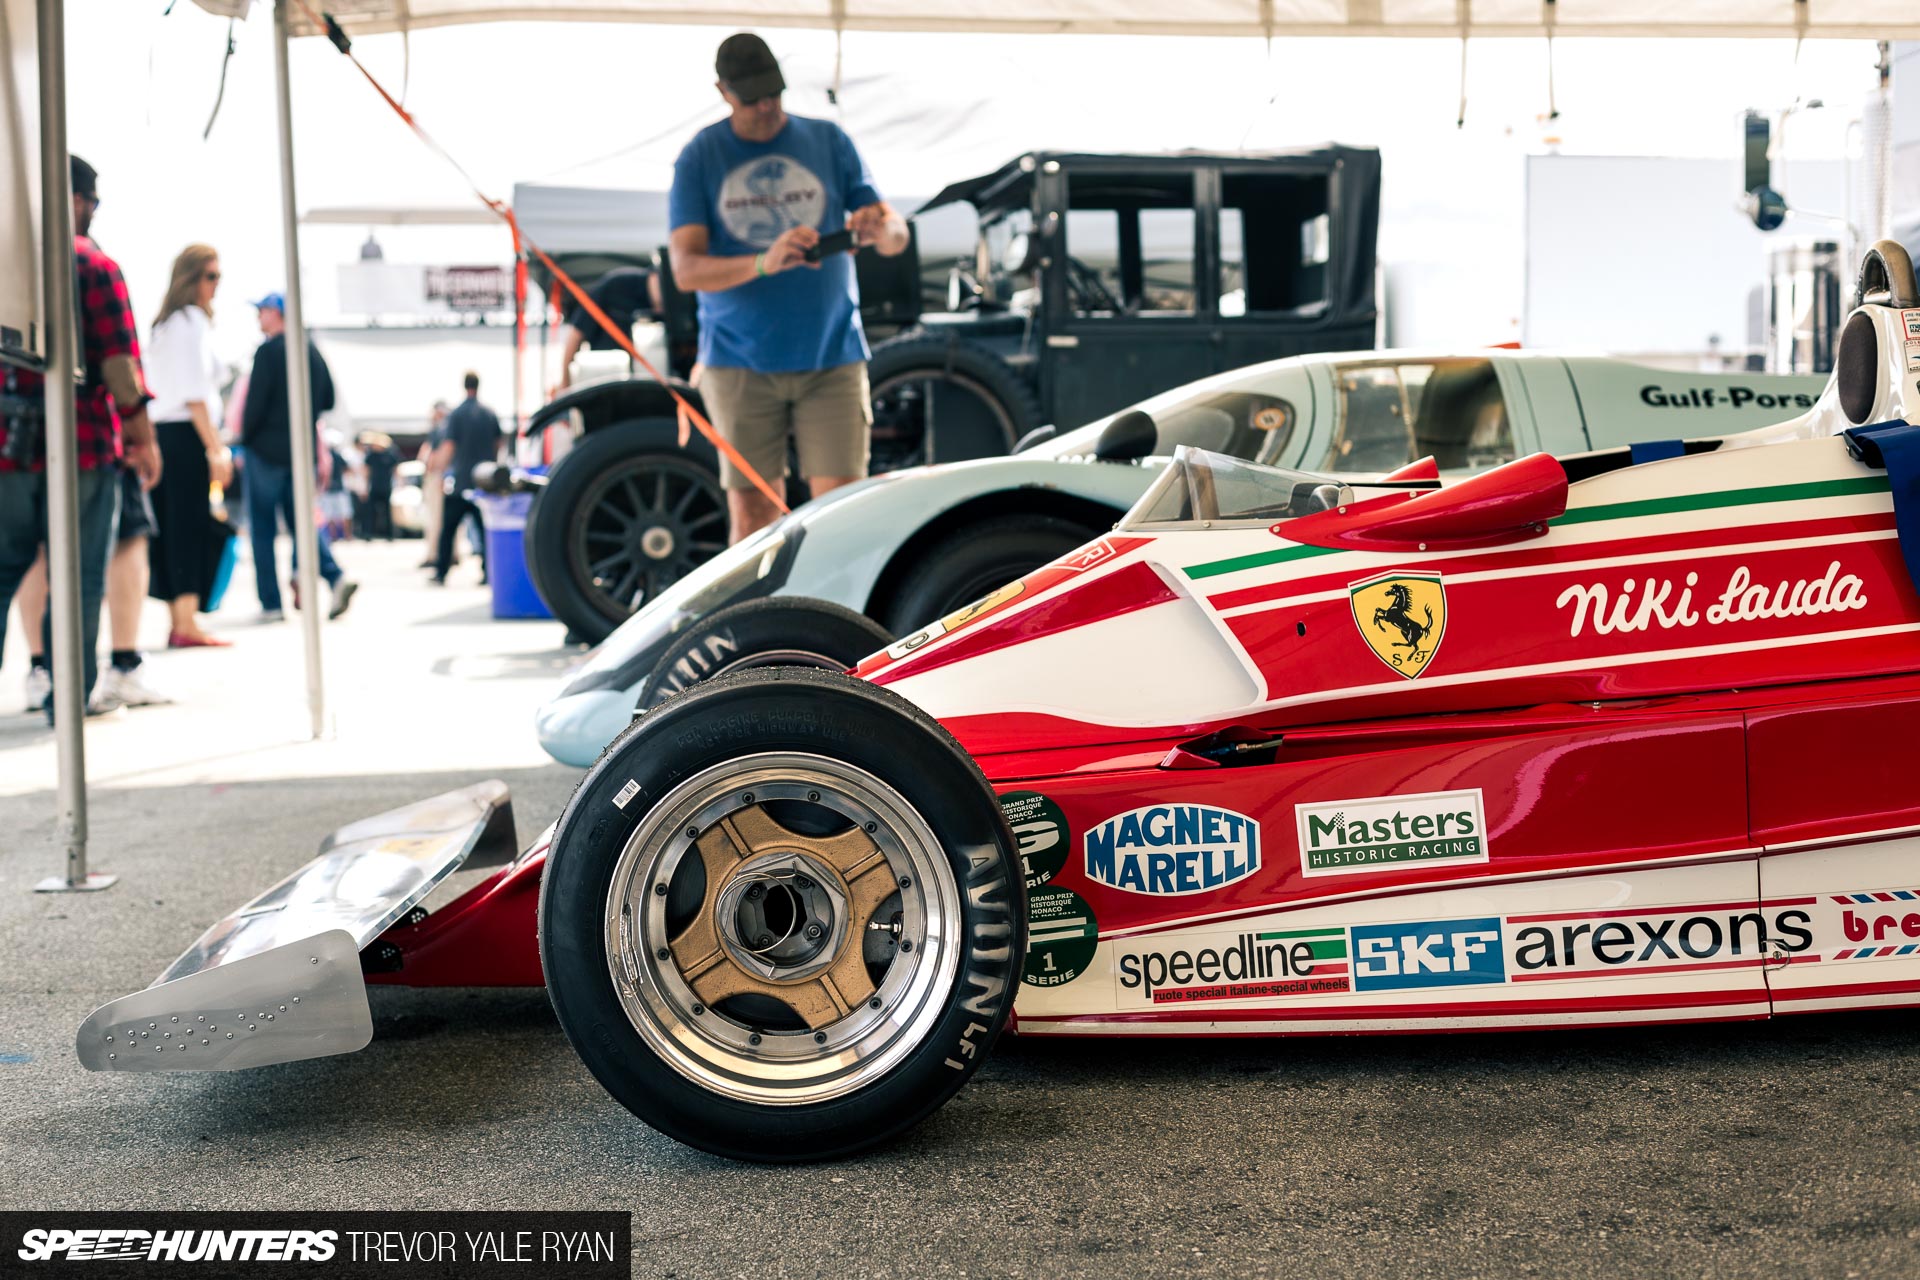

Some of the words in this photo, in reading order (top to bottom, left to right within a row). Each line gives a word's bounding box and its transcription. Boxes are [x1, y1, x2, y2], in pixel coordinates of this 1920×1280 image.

[1640, 385, 1820, 408] Gulf-Pors
[1706, 560, 1868, 624] Lauda
[1026, 796, 1044, 805] PRIX
[1008, 810, 1033, 820] ONACO
[1086, 807, 1257, 856] MAGNETI
[1308, 811, 1474, 848] Masters
[1313, 847, 1398, 865] HISTORIC
[1408, 840, 1476, 857] RACING
[1026, 870, 1051, 888] RIE
[1086, 848, 1257, 892] MARELLI
[1030, 894, 1055, 903] GRAND
[1056, 892, 1074, 900] PRIX
[1030, 899, 1072, 909] HISTORIQUE
[1031, 906, 1063, 915] MONACO
[1514, 909, 1813, 970] arexons
[1043, 952, 1057, 971] 1
[1355, 930, 1498, 978] SKF
[1027, 969, 1075, 985] SERIE
[1119, 933, 1315, 999] speedline
[1154, 989, 1183, 1001] ruote
[1186, 986, 1227, 1000] speciali
[1311, 979, 1348, 991] wheels
